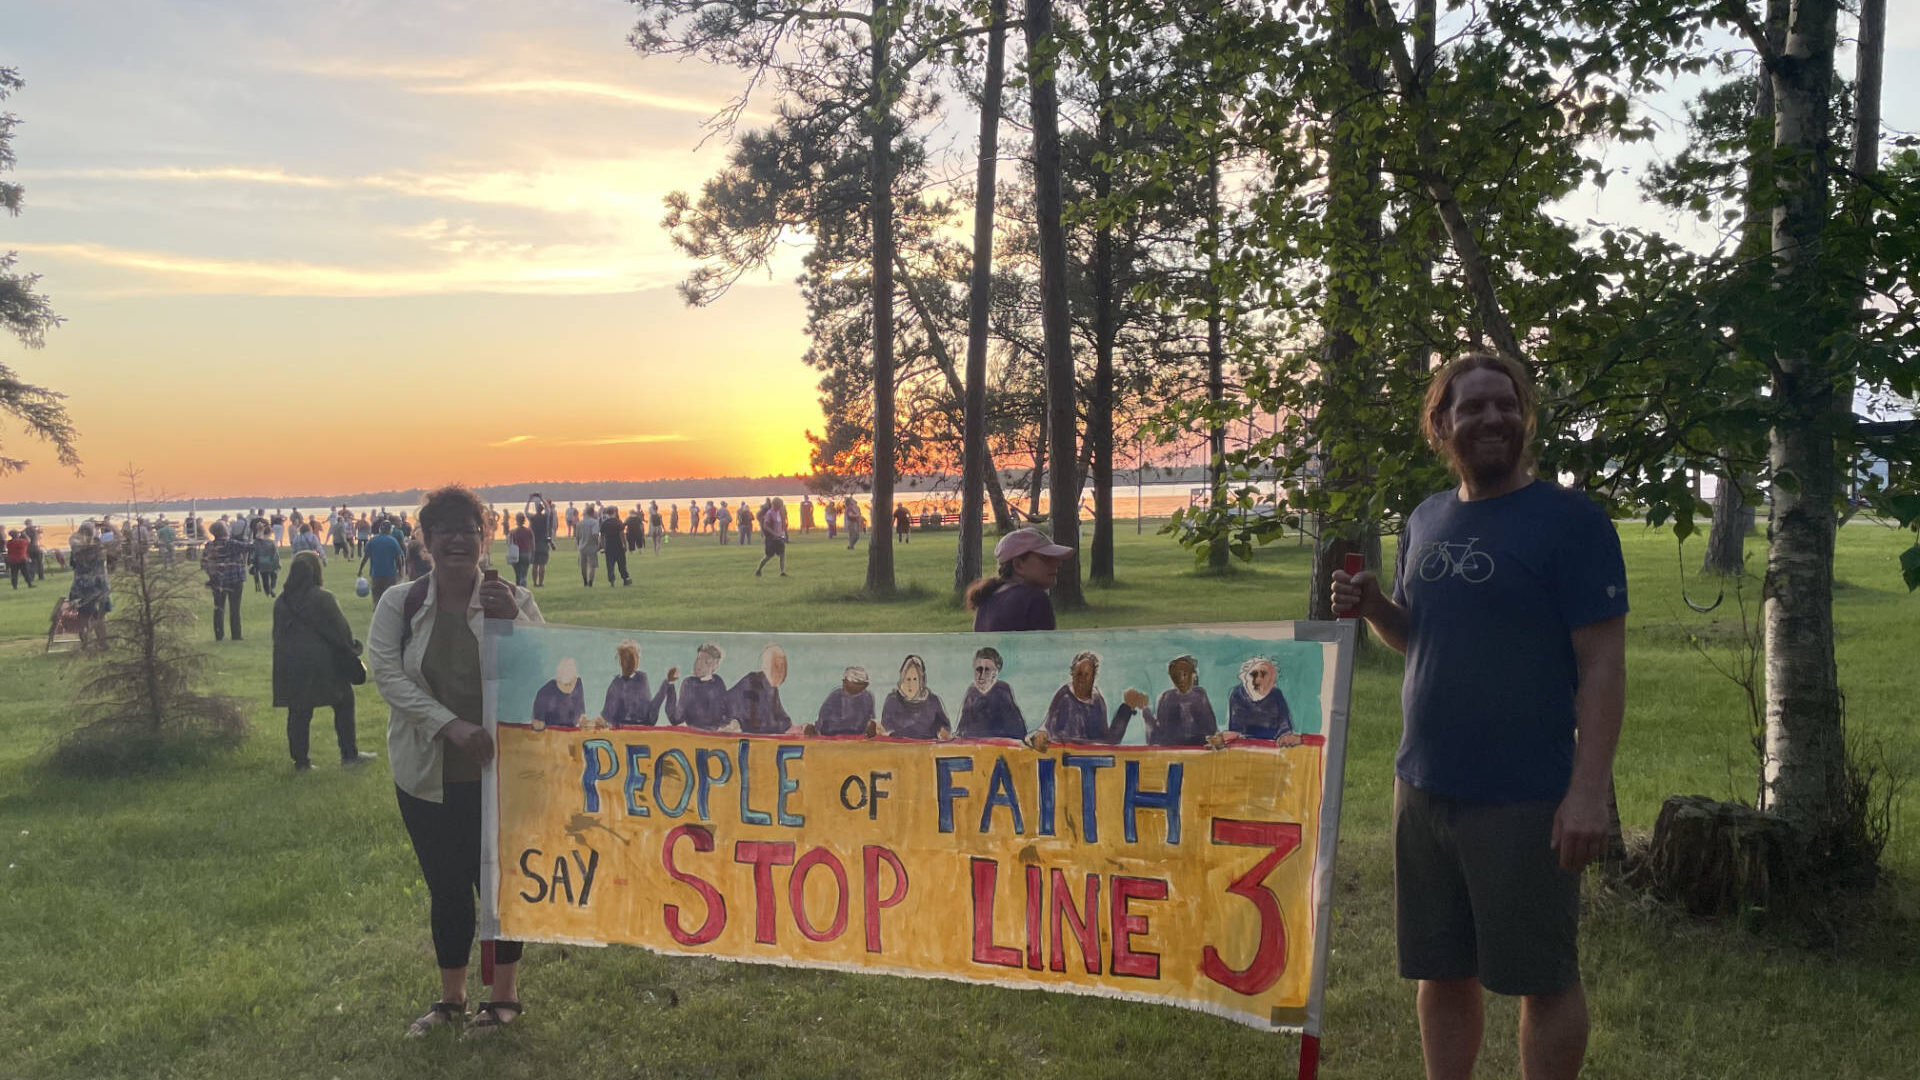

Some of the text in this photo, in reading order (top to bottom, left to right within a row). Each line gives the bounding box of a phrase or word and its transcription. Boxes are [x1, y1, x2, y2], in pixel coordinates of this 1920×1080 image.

[582, 739, 1184, 845] PEOPLE OF FAITH
[519, 817, 1302, 996] SAY STOP LINE 3
